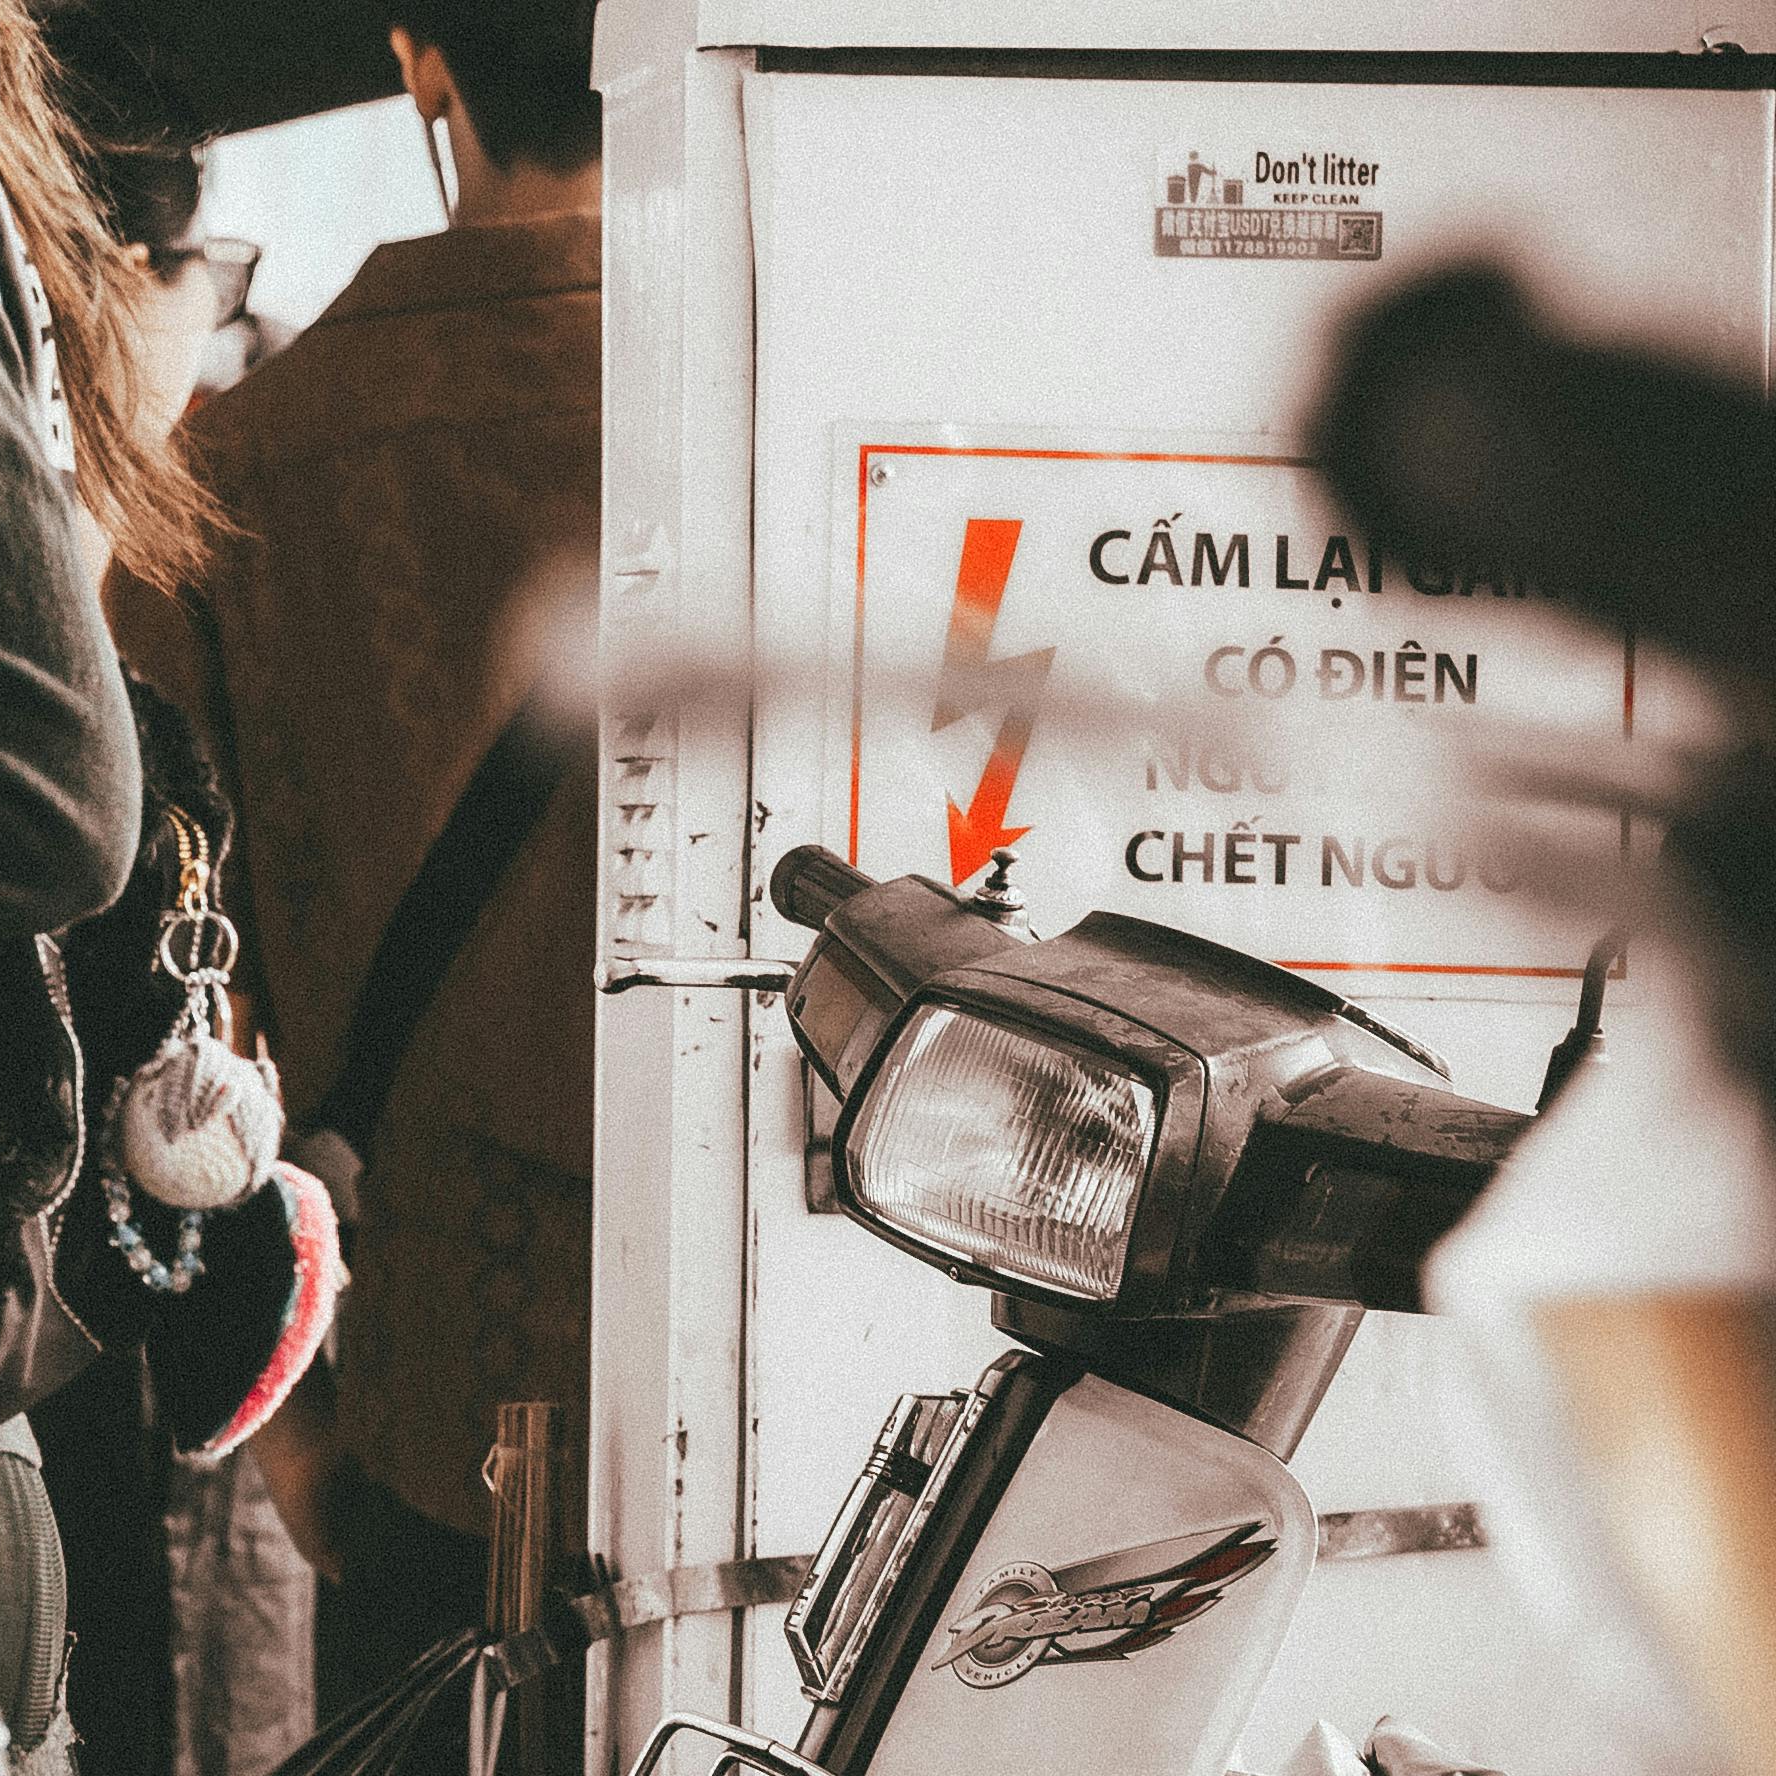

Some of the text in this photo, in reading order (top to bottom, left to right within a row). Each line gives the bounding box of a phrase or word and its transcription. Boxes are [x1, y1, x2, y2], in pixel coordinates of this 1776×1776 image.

[1255, 151, 1379, 186] Don't litter
[1273, 193, 1360, 205] KEEP CLEAN
[1089, 513, 1250, 588] CẤM
[1204, 636, 1297, 699] CÓ
[1125, 816, 1301, 885] CHẾT
